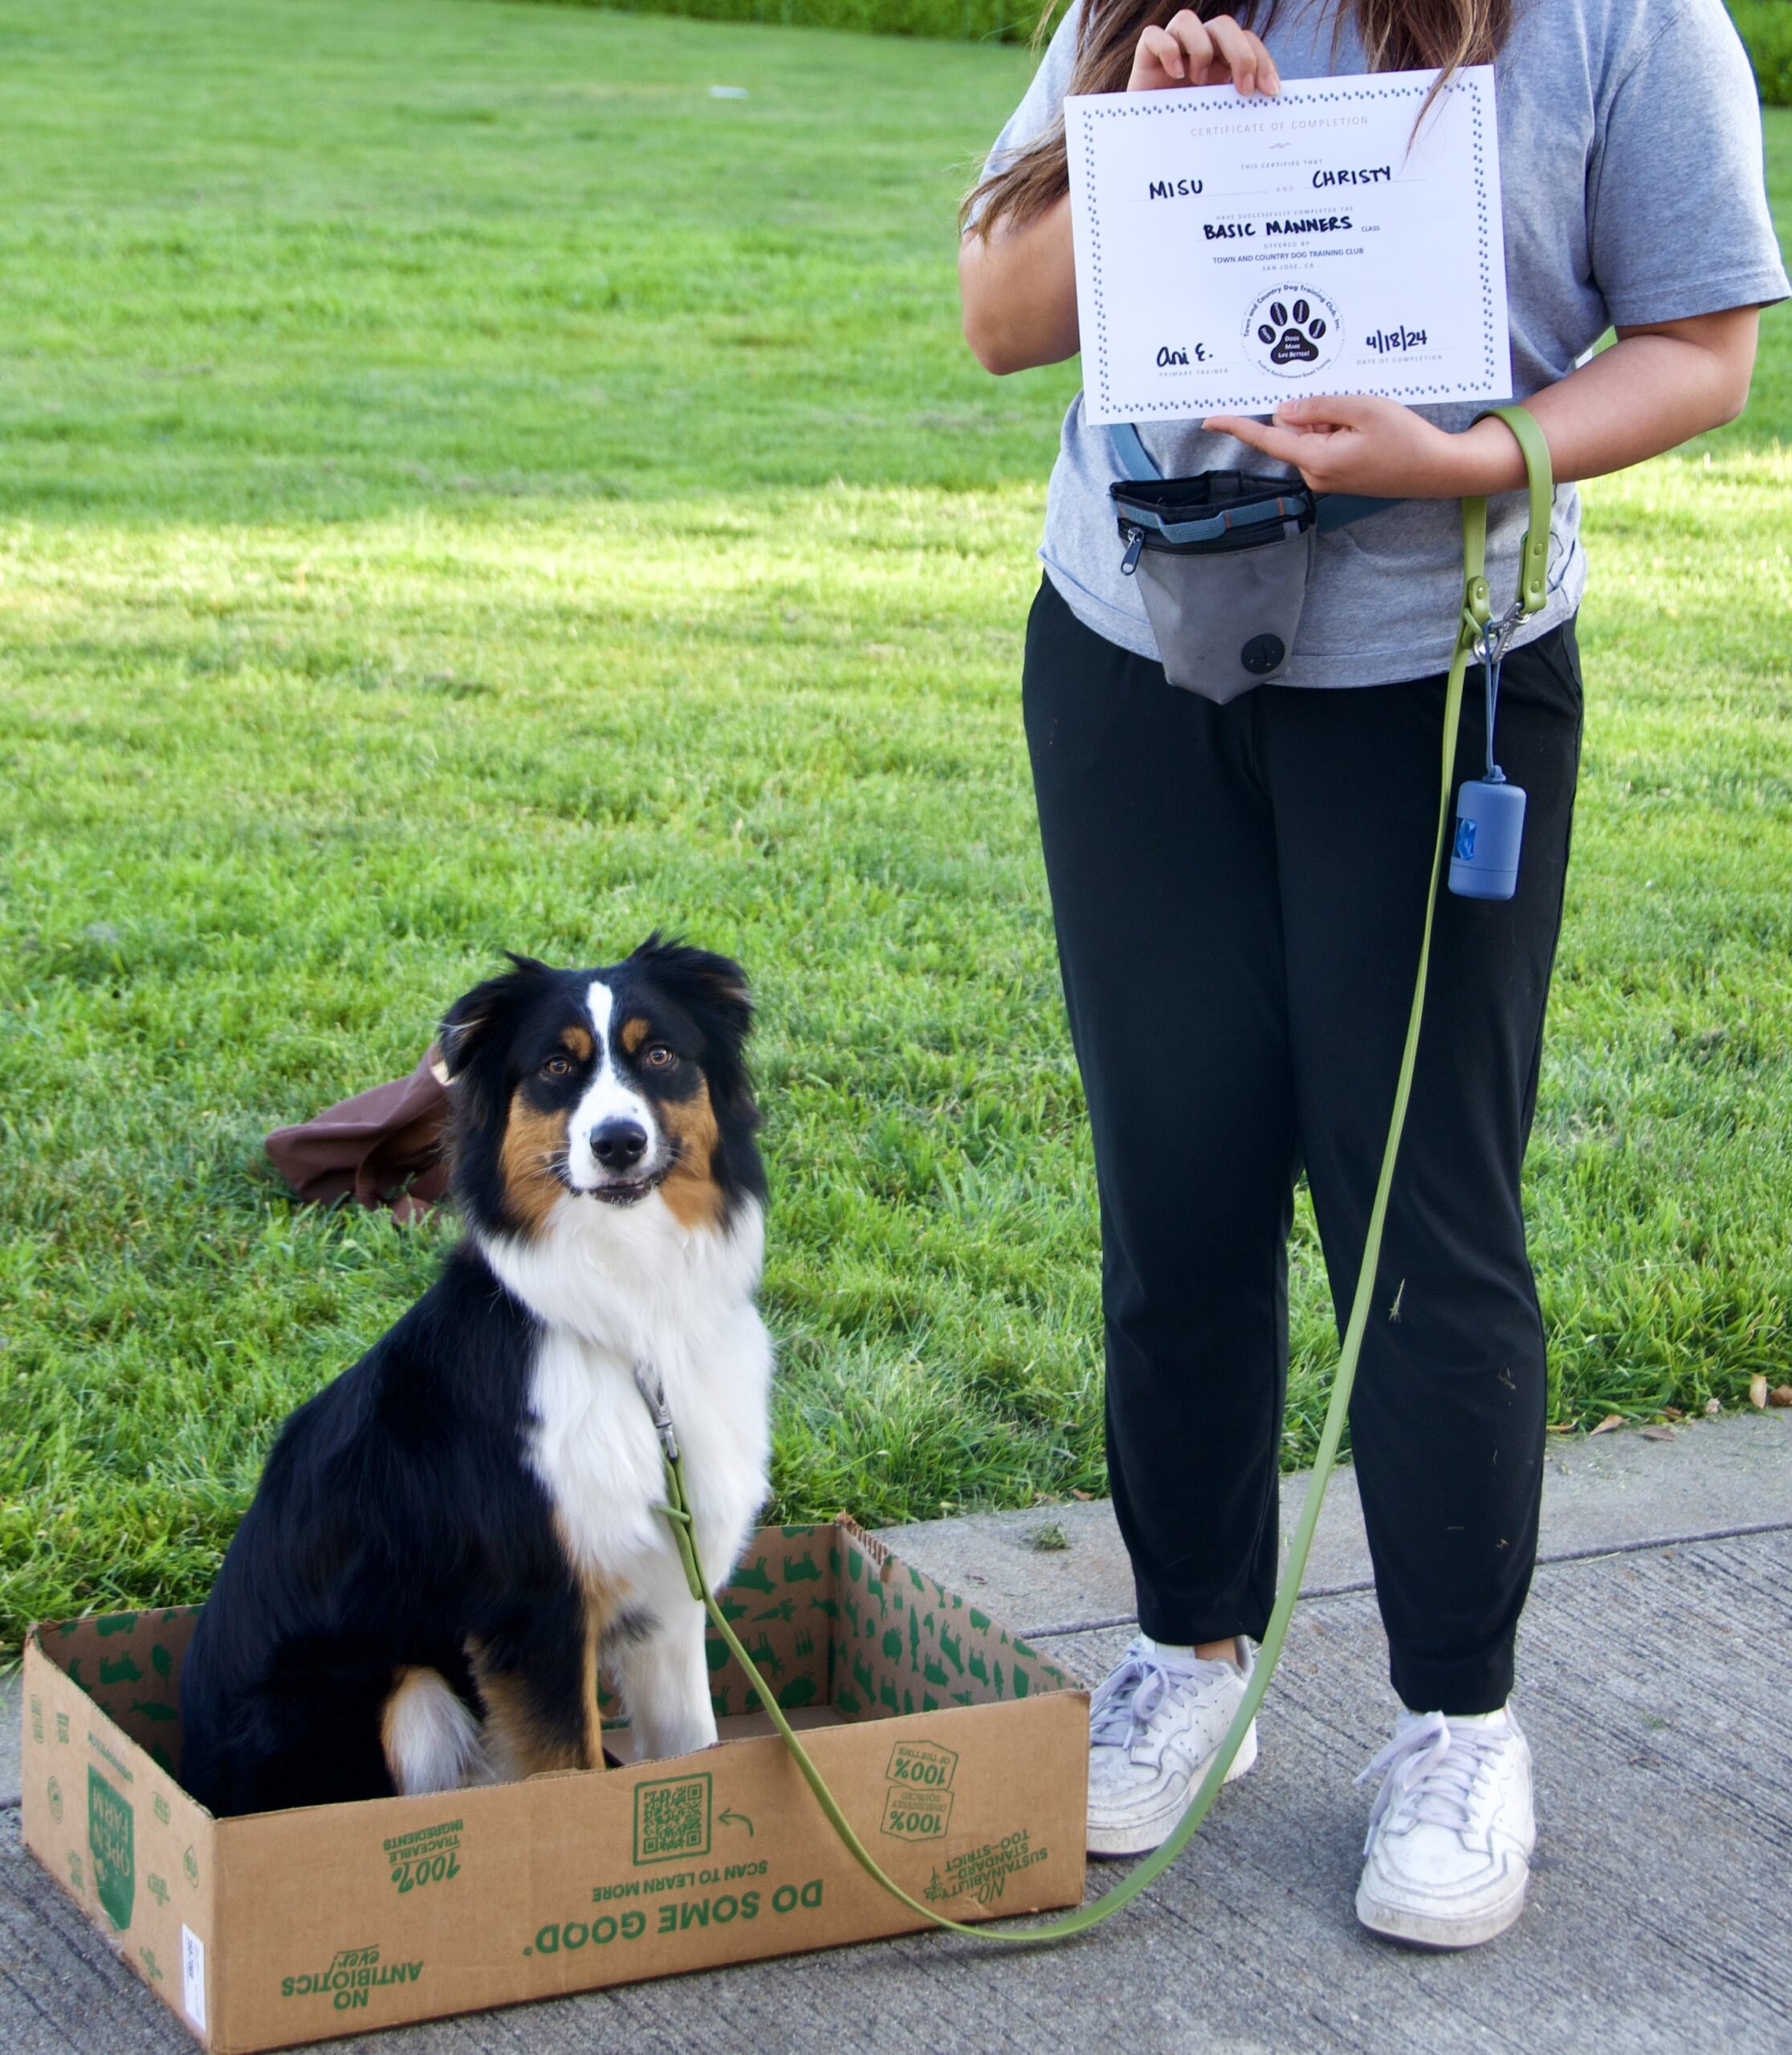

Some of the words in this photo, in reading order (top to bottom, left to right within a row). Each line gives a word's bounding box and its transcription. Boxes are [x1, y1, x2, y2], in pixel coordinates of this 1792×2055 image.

[1191, 123, 1265, 136] CERTIFICATE
[1271, 121, 1285, 131] OF
[1291, 116, 1368, 129] COMPLETION
[1261, 161, 1300, 169] CERTIFIES
[1312, 165, 1392, 189] CHRISTY
[1149, 179, 1203, 200] MISU
[1238, 210, 1291, 219] SUCCESSFULLY
[1294, 207, 1337, 215] COMPLETED
[1203, 222, 1256, 240] BASIC
[1265, 216, 1353, 236] MANNERS
[1213, 256, 1236, 264] TOWN
[1237, 254, 1253, 262] AND
[1255, 253, 1289, 262] COUNTRY
[1309, 249, 1343, 258] TRAINING
[1346, 247, 1364, 255] CLUB
[1244, 318, 1252, 337] Town
[1249, 303, 1258, 317] and
[1257, 287, 1281, 303] Country
[1300, 285, 1326, 303] Training
[1366, 324, 1427, 354] 4/18/24
[1392, 355, 1443, 363] COMPLETION
[894, 1758, 945, 1786] 100%
[92, 1784, 128, 1844] FARM
[890, 1811, 941, 1834] 100%
[382, 1818, 464, 1851] INGREDIENTS
[92, 1821, 130, 1877] OPEN
[389, 1834, 459, 1863] TRACEABLE
[391, 1852, 461, 1894] 100%
[643, 1871, 694, 1894] LEARN
[698, 1867, 720, 1884] TO
[724, 1860, 768, 1881] SCAN
[941, 1847, 1049, 1900] SUSTAINABILITY
[591, 1881, 640, 1902] MORE
[772, 1878, 823, 1914] DO
[658, 1890, 760, 1934] SOME
[281, 1961, 424, 1997] ANTIBIOTICS
[333, 1988, 369, 2011] NO
